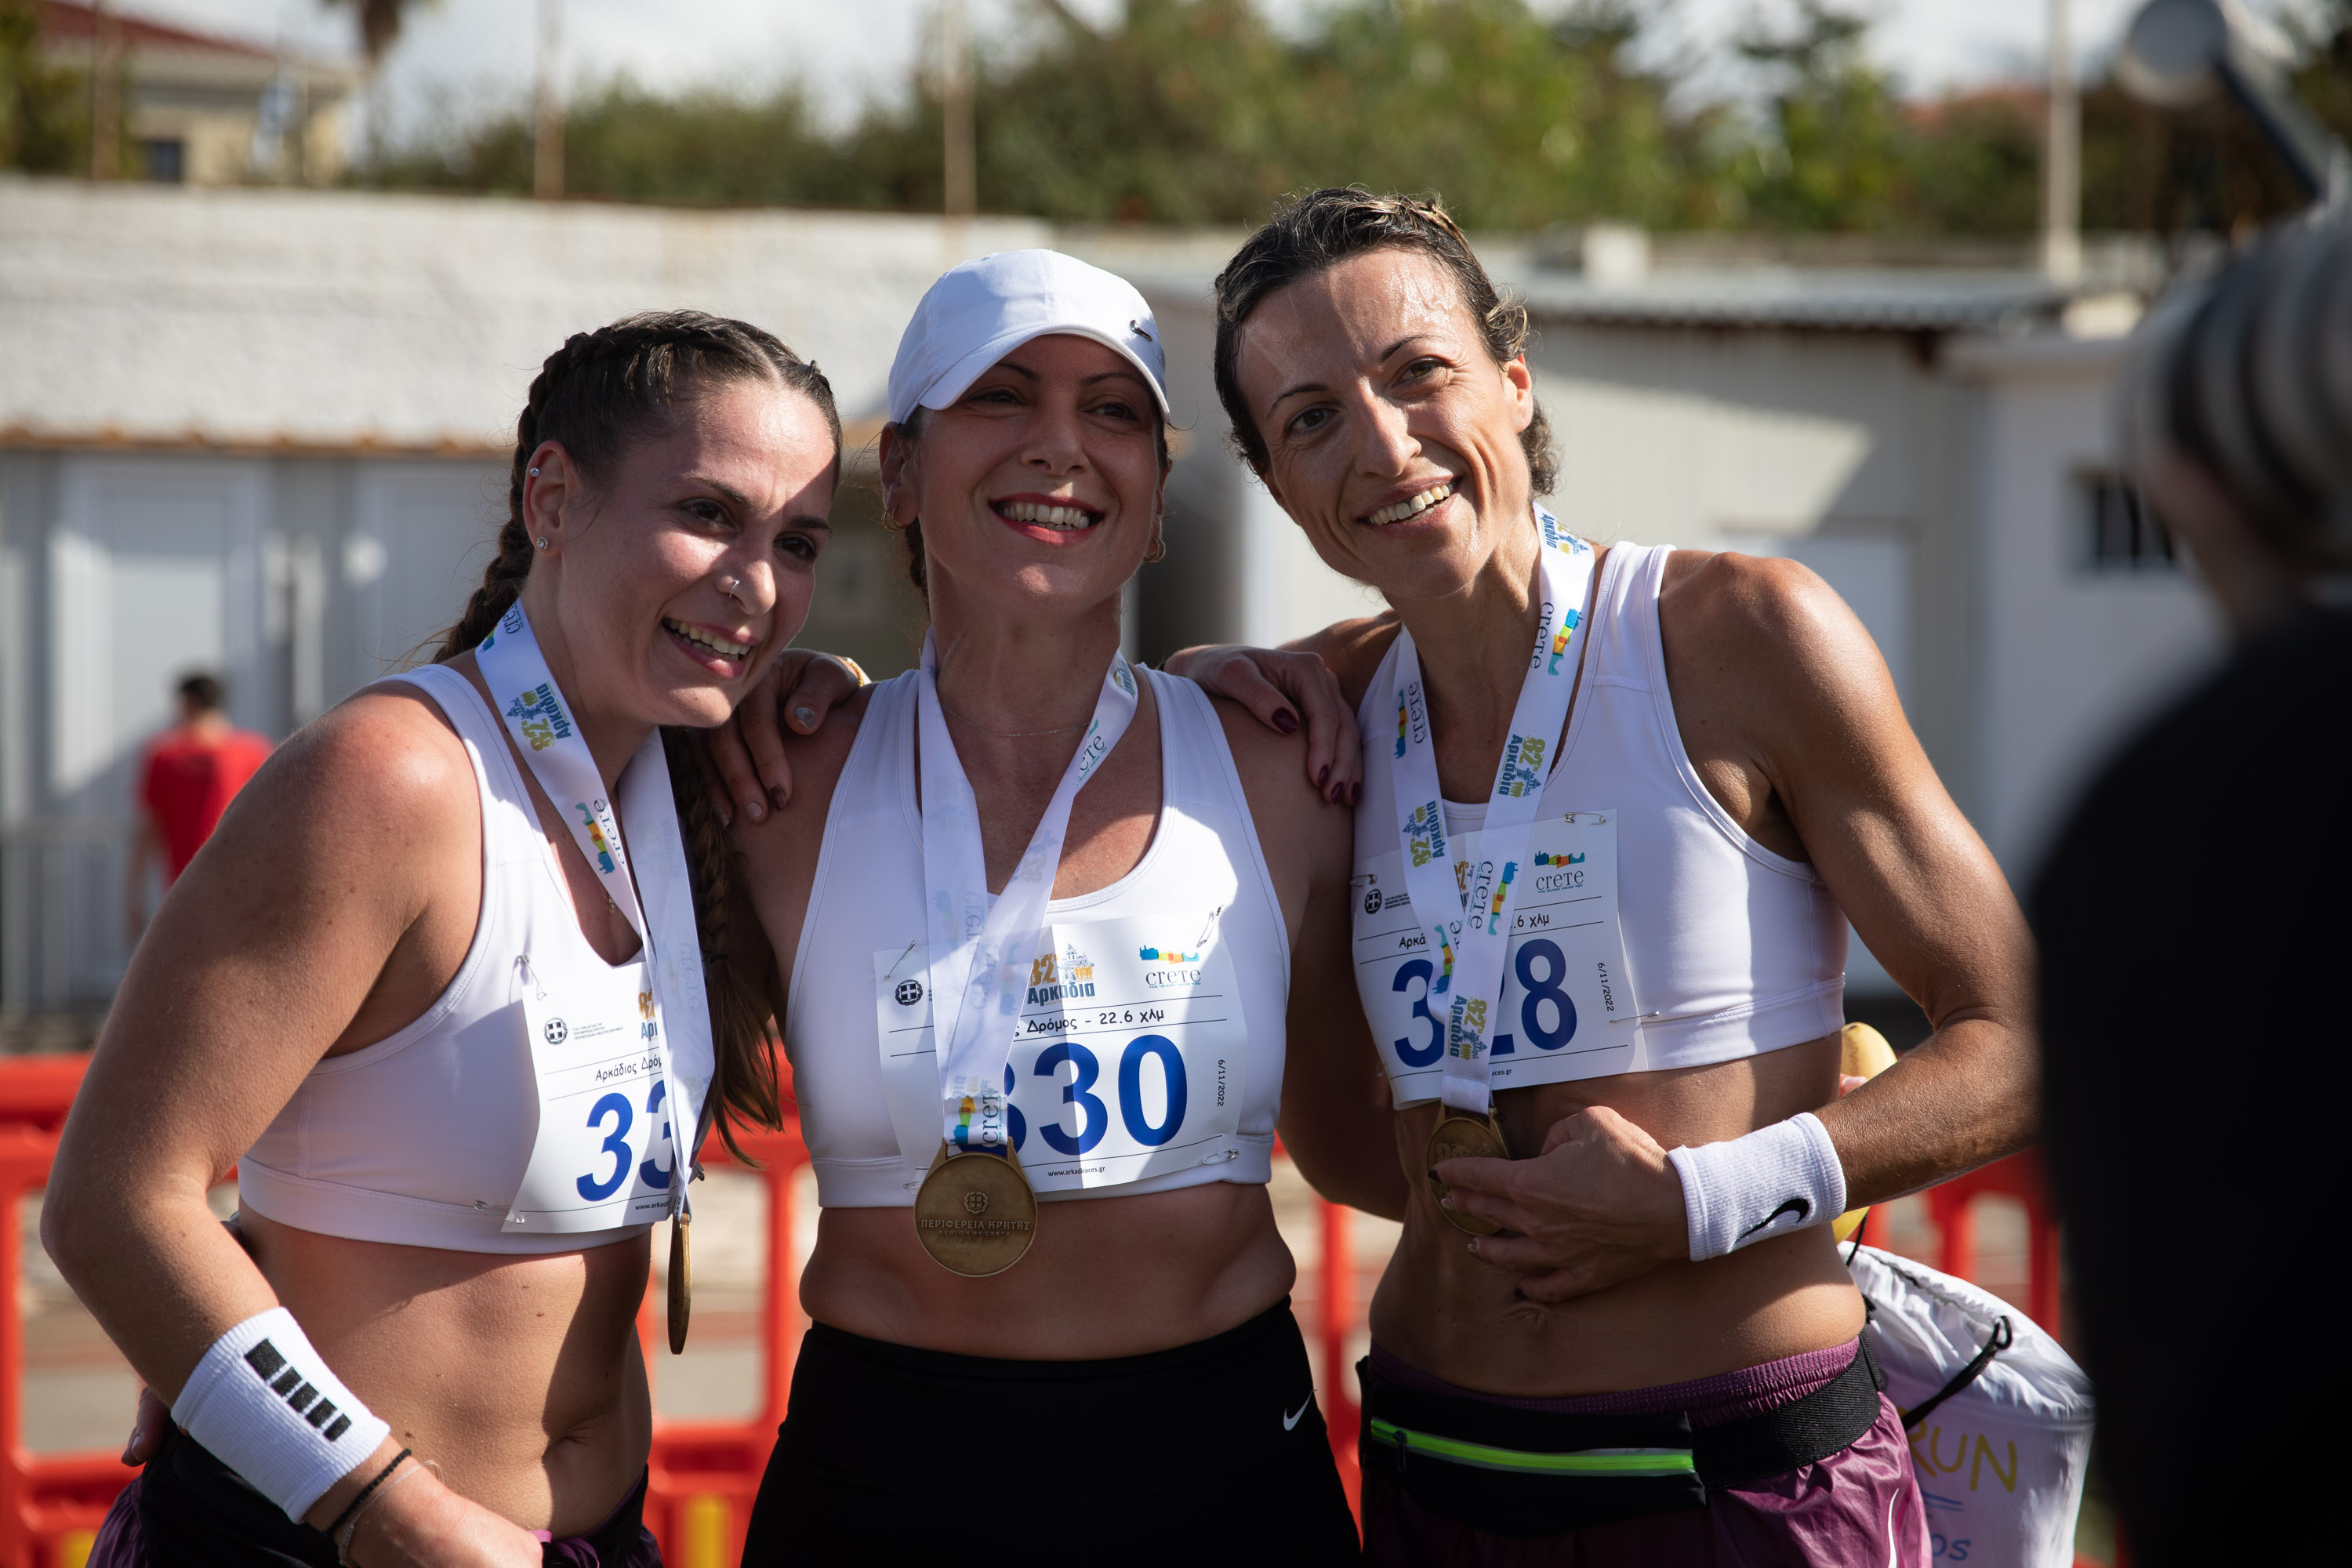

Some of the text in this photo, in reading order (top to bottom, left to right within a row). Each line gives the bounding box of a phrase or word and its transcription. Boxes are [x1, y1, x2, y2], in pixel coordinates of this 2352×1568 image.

[1392, 938, 1577, 1068] 38
[1598, 962, 1614, 1012] 6/11/2022
[1027, 1018, 1077, 1033] Δρόμος
[1099, 1010, 1133, 1025] 22.6
[595, 1062, 637, 1082] Αρκάδιος
[1218, 1059, 1226, 1108] 6/11/2022
[1047, 1167, 1105, 1176] www.arkadiraces.gr
